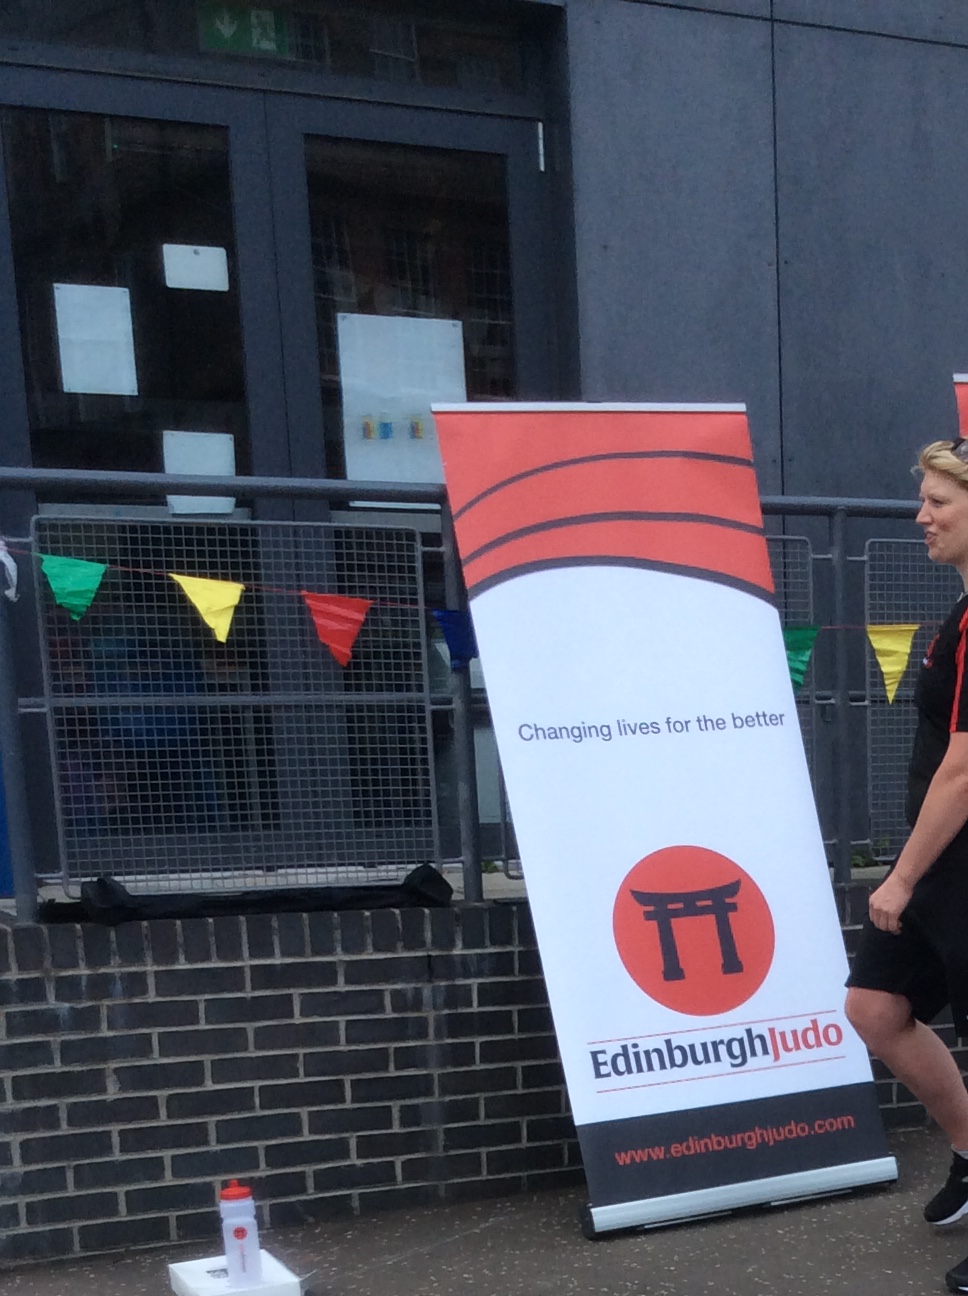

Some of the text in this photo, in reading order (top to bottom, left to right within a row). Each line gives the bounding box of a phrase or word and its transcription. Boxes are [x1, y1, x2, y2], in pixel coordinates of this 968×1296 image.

[518, 710, 785, 744] Changing lives for the better
[614, 1115, 855, 1166] www.edinburghjudo.com
